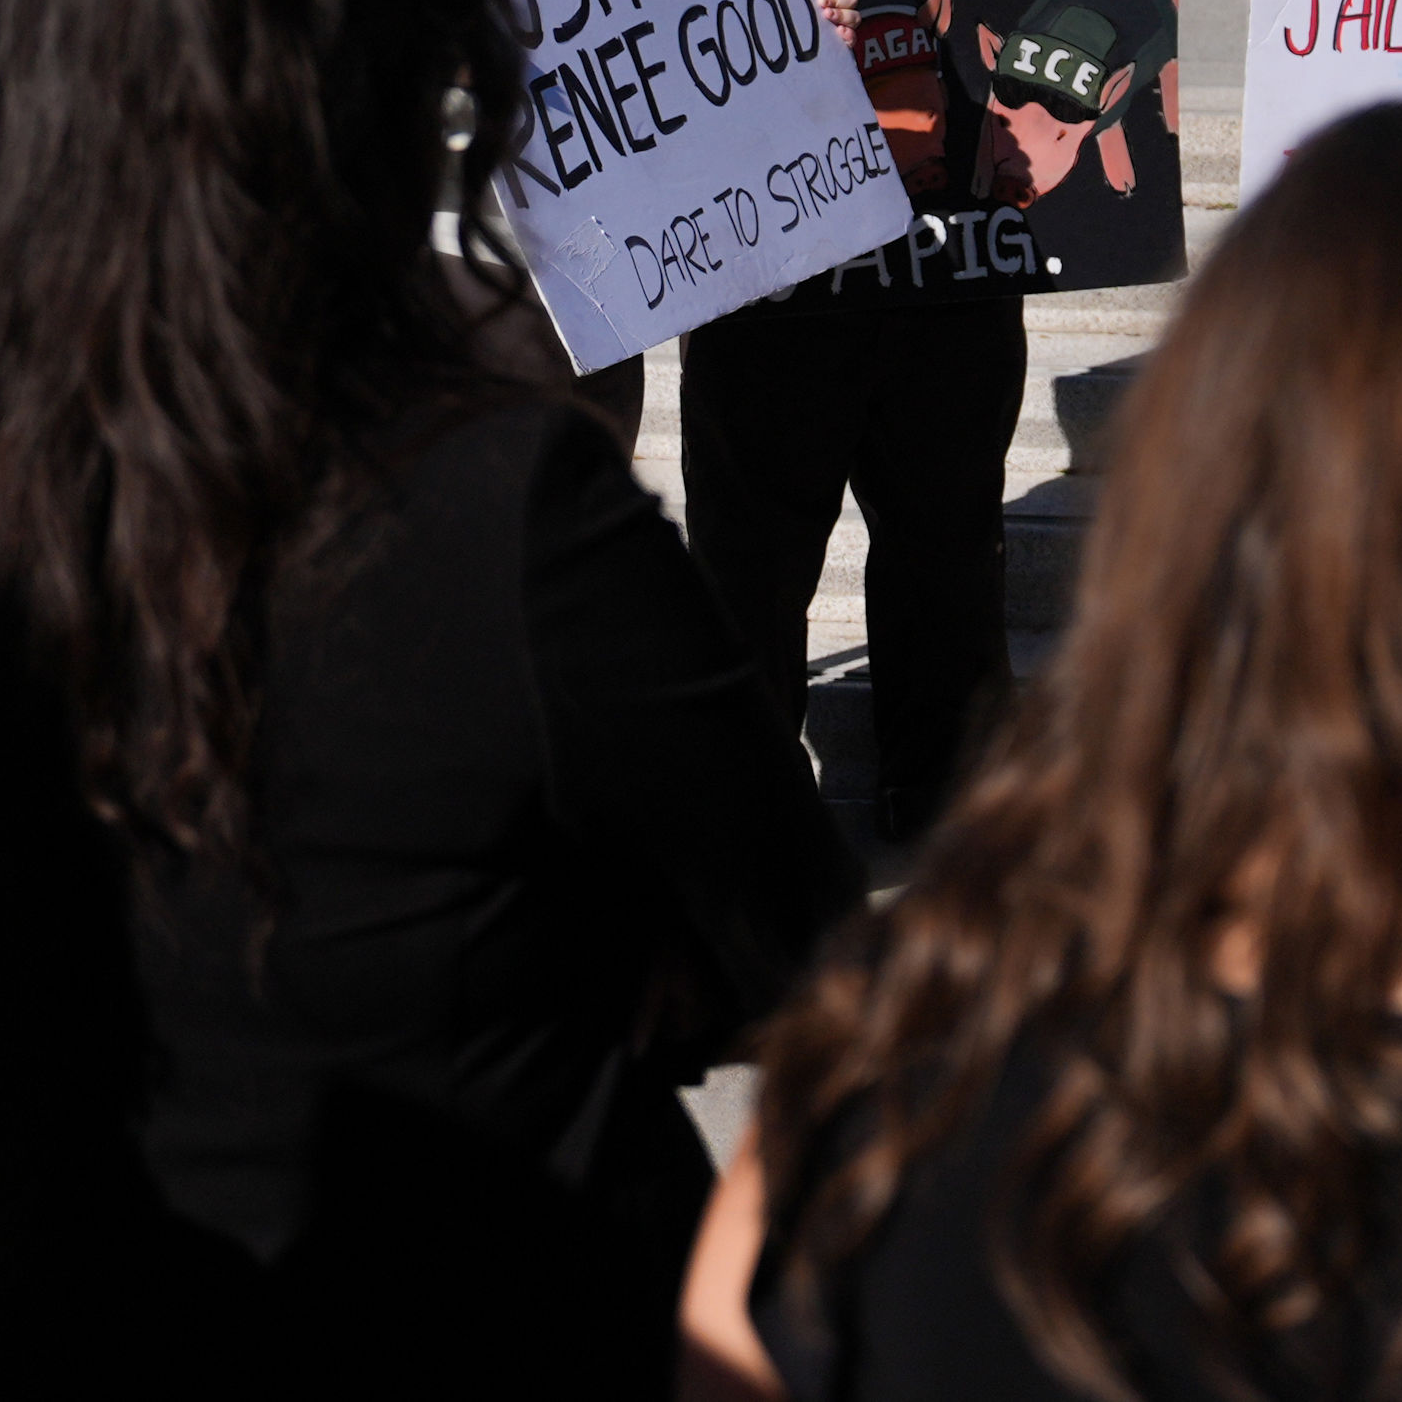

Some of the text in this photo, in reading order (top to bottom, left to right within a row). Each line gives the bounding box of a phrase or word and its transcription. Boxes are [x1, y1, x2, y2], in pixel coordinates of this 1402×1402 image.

[499, 20, 688, 210] RENEE
[1012, 36, 1101, 97] ICE
[624, 121, 891, 310] DARE TO STRUGGLE
[906, 205, 1063, 289] PIG.
